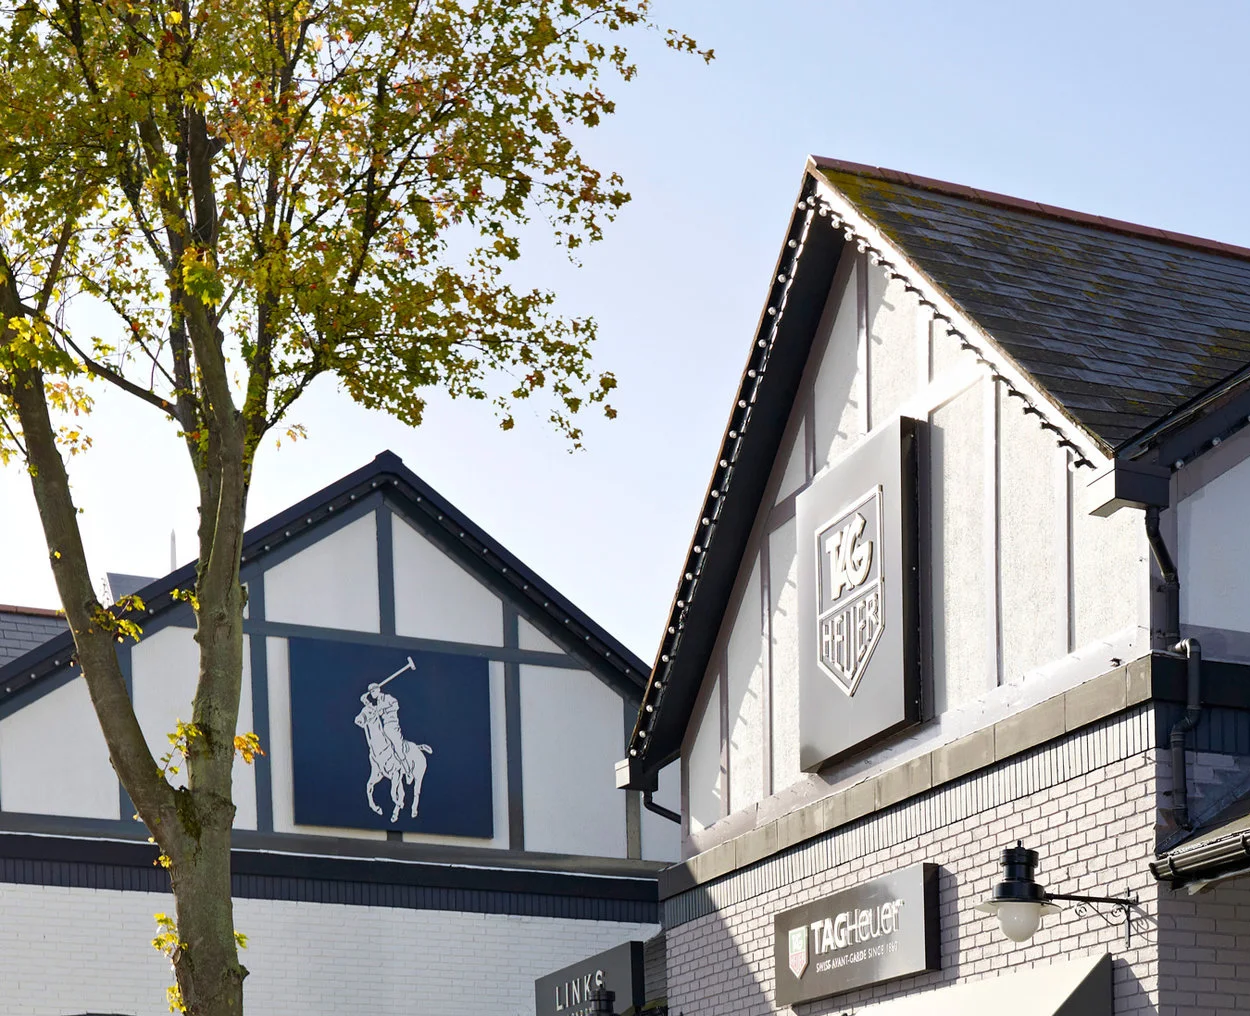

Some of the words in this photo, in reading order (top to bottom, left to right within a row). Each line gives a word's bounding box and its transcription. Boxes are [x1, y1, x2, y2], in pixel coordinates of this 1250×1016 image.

[825, 512, 874, 601] TAG
[822, 592, 880, 681] HEUER
[555, 969, 604, 1011] LINKS
